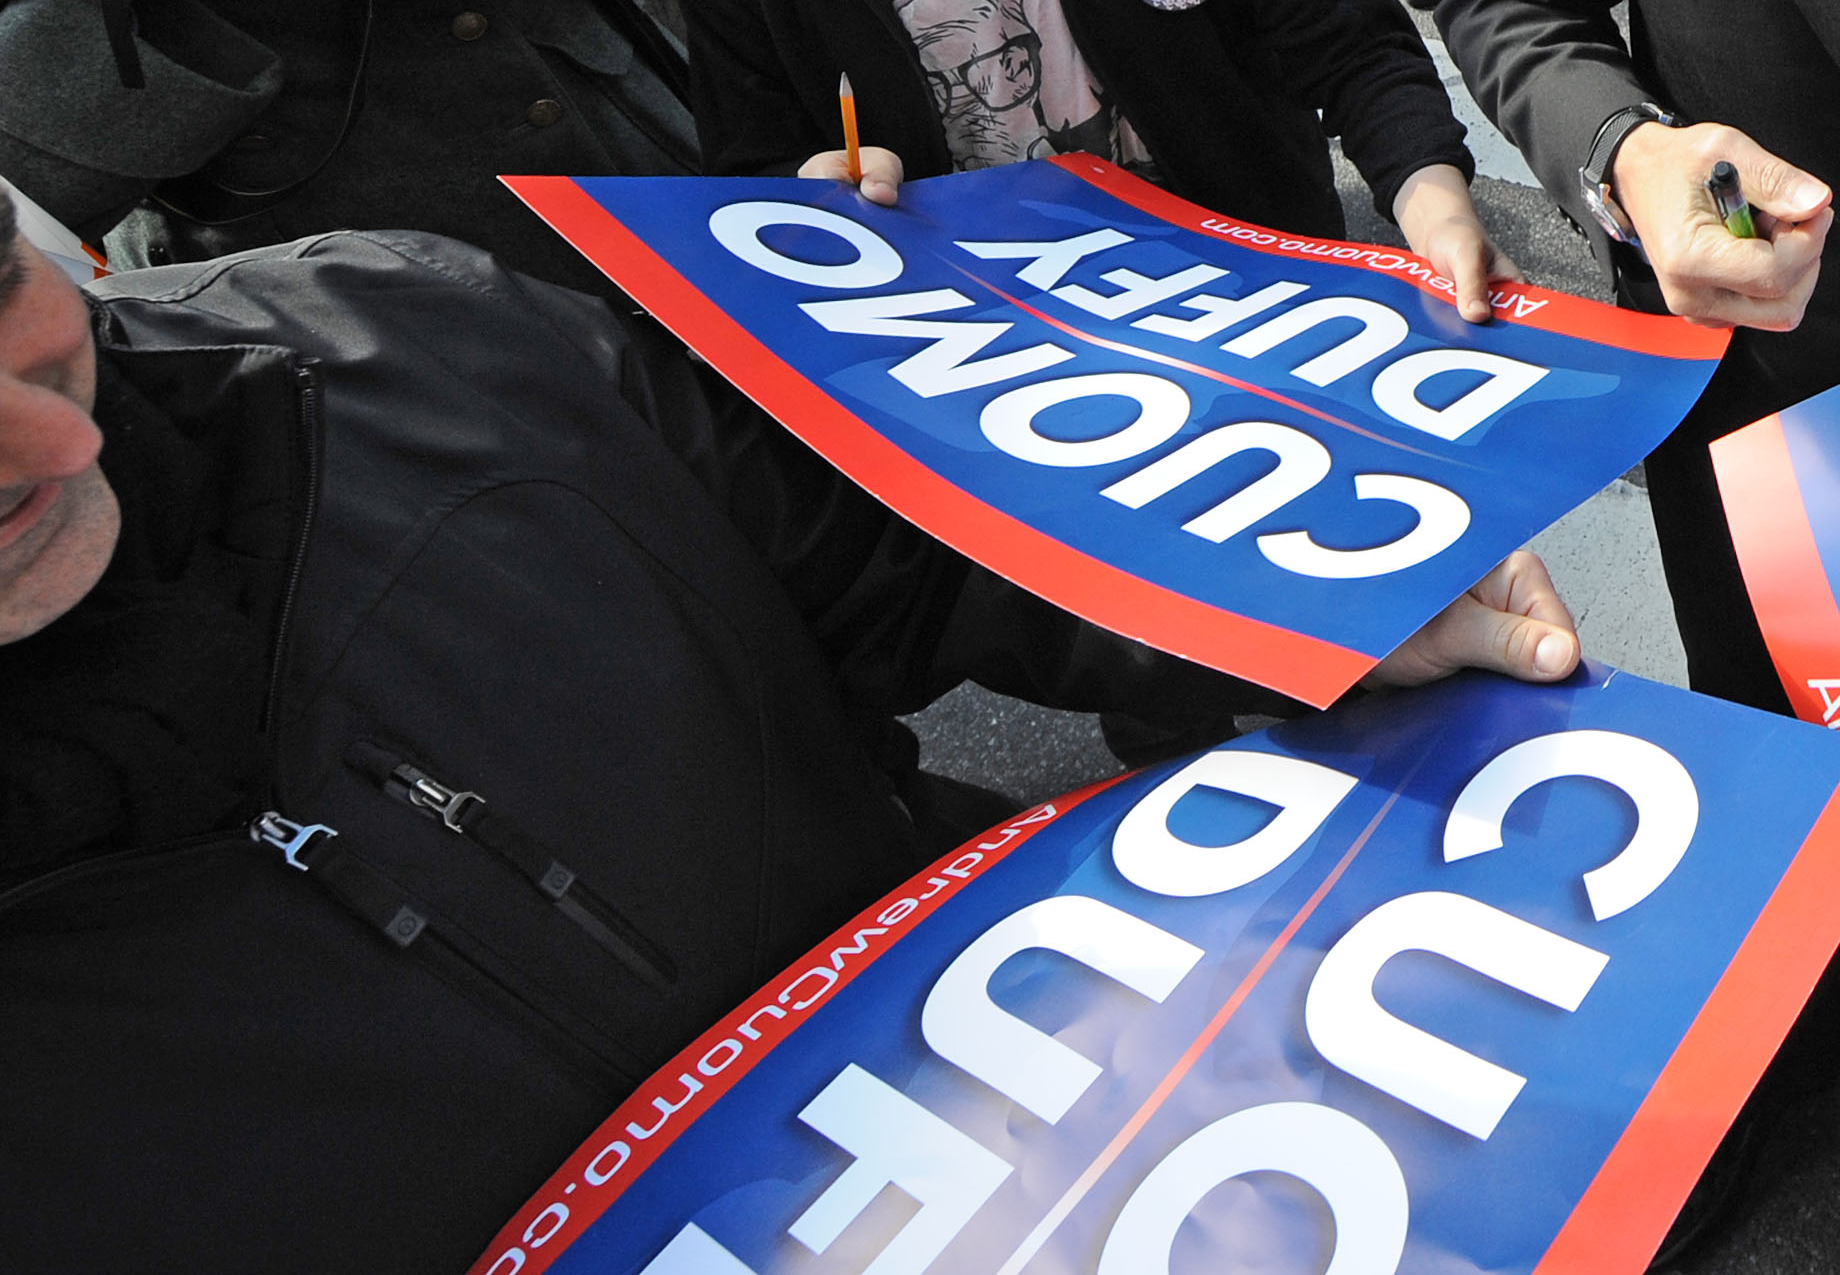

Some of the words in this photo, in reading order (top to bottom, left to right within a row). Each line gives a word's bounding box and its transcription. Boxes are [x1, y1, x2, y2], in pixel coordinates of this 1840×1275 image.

[708, 201, 1471, 579] CUOMO
[952, 229, 1551, 442] DUFFY
[1200, 217, 1549, 318] AnewCuomo.com
[638, 750, 1360, 1275] DUF
